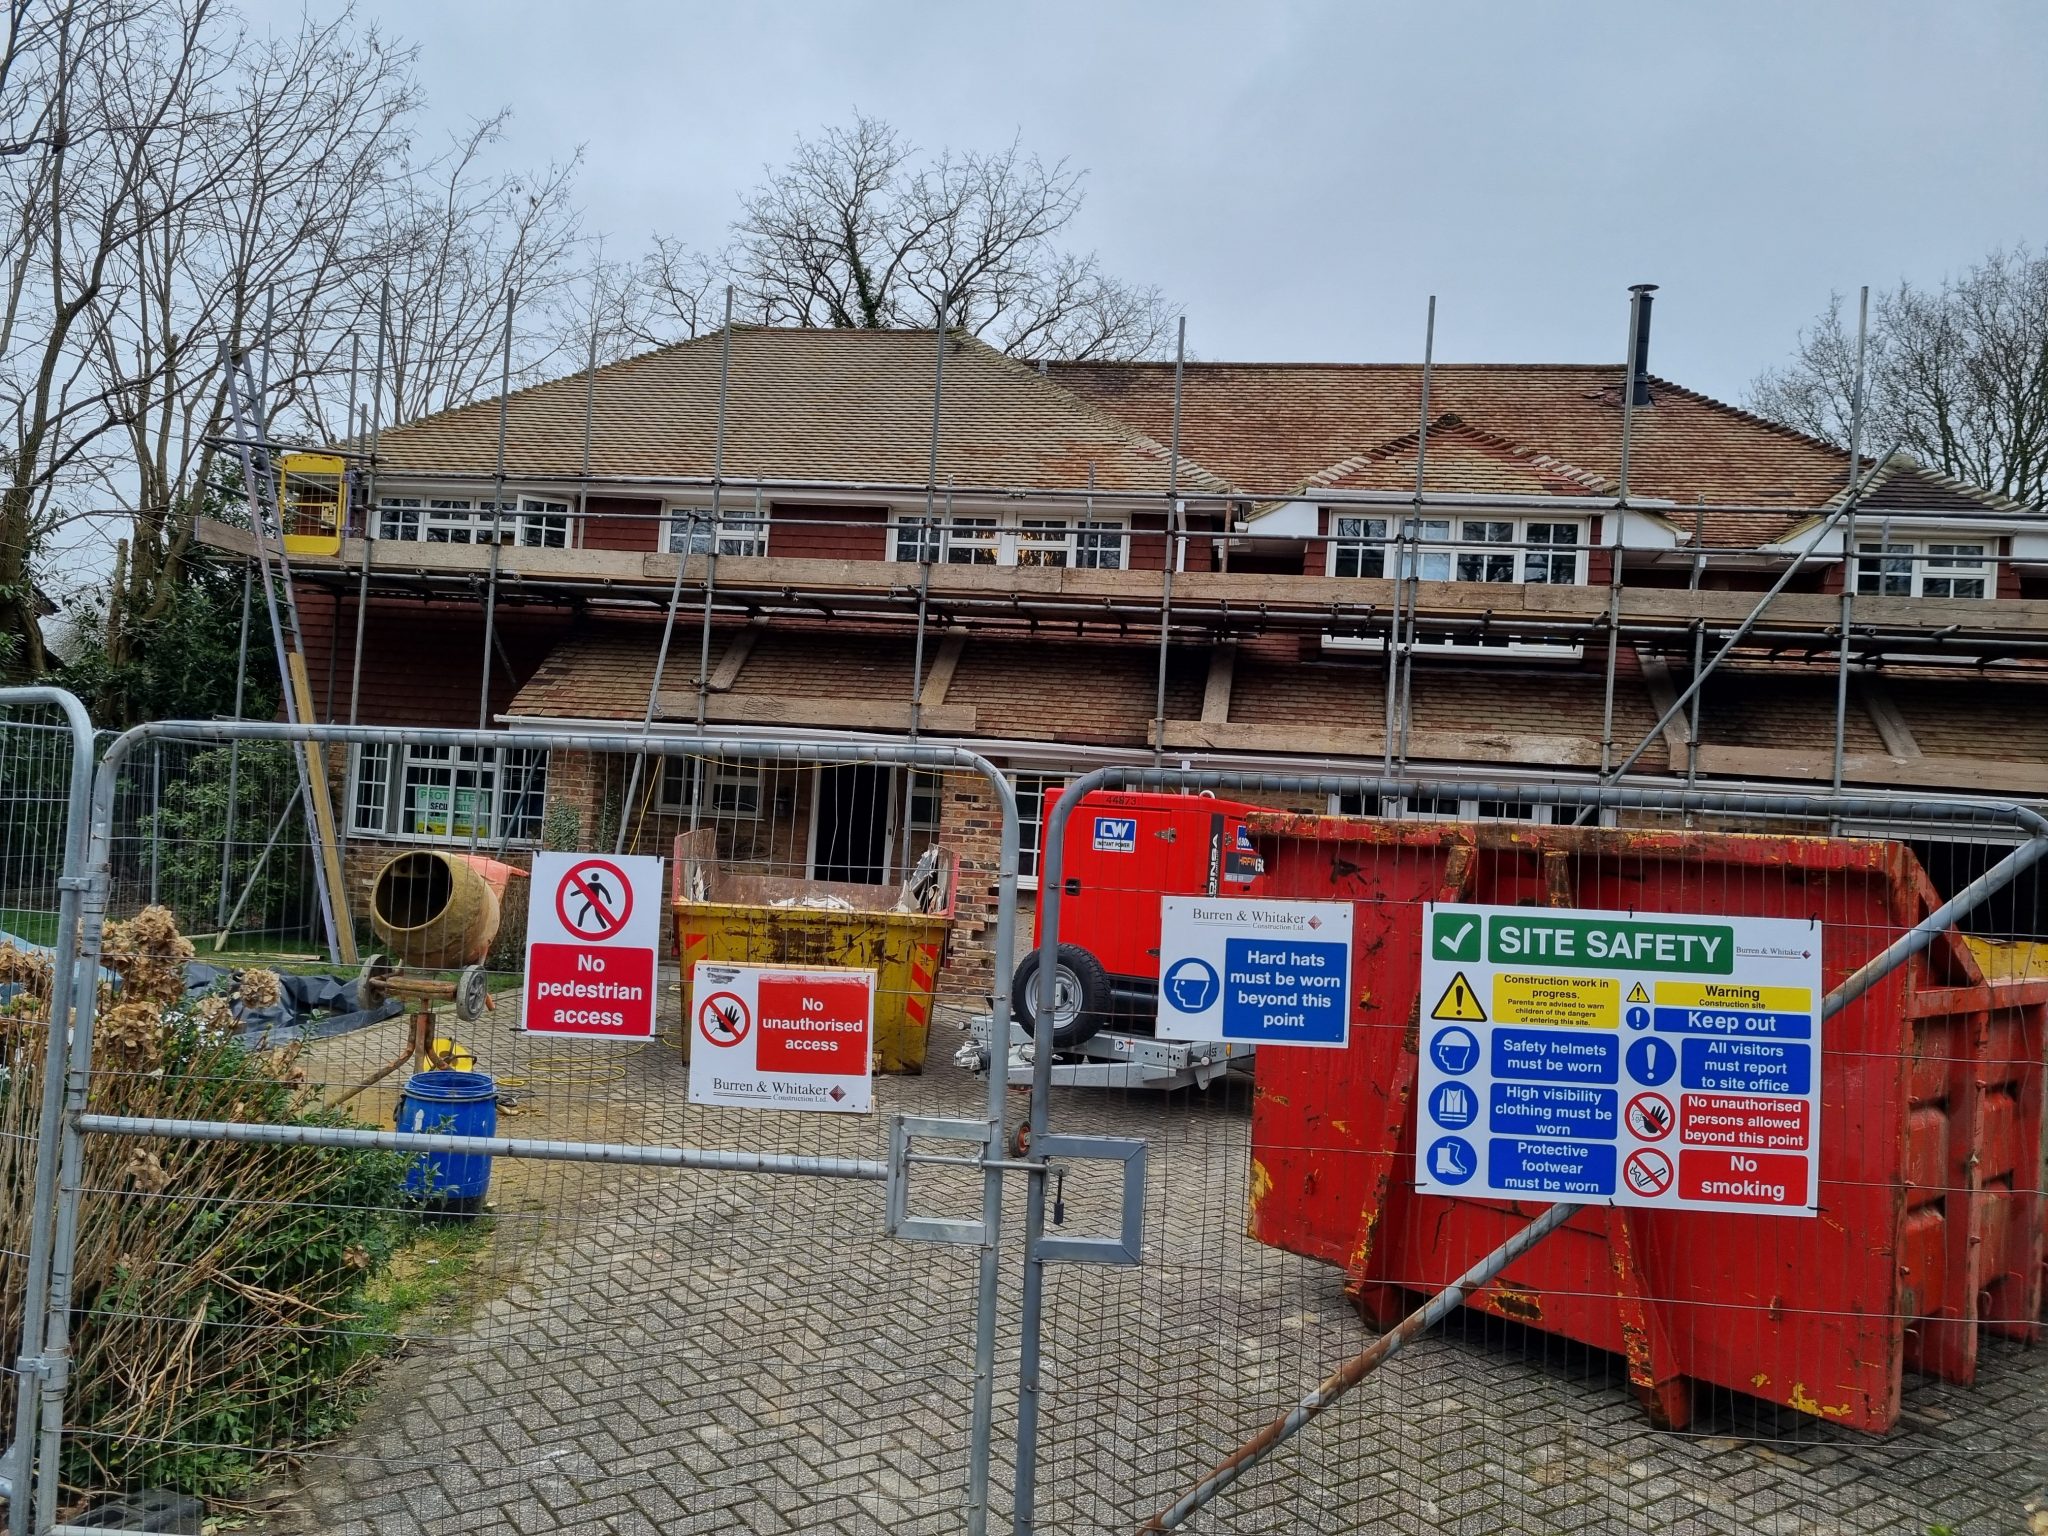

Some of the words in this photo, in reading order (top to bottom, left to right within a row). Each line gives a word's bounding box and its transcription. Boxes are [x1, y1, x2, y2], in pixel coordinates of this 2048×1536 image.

[420, 791, 483, 803] PROTCTE
[1100, 821, 1130, 838] CW
[1193, 907, 1233, 921] Burren
[1236, 910, 1248, 922] &
[1251, 910, 1306, 924] Whitaker
[1252, 922, 1292, 931] Construction
[1499, 926, 1575, 957] SITE
[1586, 930, 1722, 963] SAFETY
[1736, 946, 1760, 954] Burren
[1760, 947, 1768, 955] &
[1769, 947, 1802, 956] Whitaker
[578, 954, 605, 972] No
[1247, 950, 1286, 965] Hard
[1290, 952, 1326, 967] hats
[1230, 971, 1271, 985] must
[1275, 971, 1295, 986] be
[1299, 975, 1341, 988] worn
[1504, 974, 1569, 987] Construction
[1572, 978, 1597, 988] work
[1599, 979, 1609, 989] in
[537, 980, 642, 1000] pedestrian
[1532, 989, 1581, 1000] progress.
[1705, 985, 1760, 1001] Warning
[802, 997, 824, 1011] No
[1237, 990, 1298, 1008] beyond
[1301, 993, 1332, 1008] this
[1507, 998, 1535, 1007] Parents
[1536, 1000, 1547, 1008] are
[1548, 1000, 1577, 1009] advised
[1578, 1002, 1586, 1010] to
[1699, 999, 1749, 1009] Construction
[1751, 1001, 1766, 1010] site
[553, 1008, 624, 1026] access
[1263, 1012, 1305, 1028] point
[1515, 1007, 1544, 1016] children
[1545, 1008, 1554, 1016] of
[1554, 1009, 1566, 1017] the
[1567, 1010, 1597, 1019] dangers
[762, 1017, 863, 1032] unauthorised
[1529, 1017, 1559, 1026] entering
[1560, 1018, 1574, 1026] this
[1575, 1019, 1591, 1027] site.
[1688, 1011, 1739, 1034] Keep
[1744, 1016, 1777, 1032] out
[785, 1039, 839, 1052] access
[1503, 1039, 1547, 1056] Safety
[1551, 1041, 1607, 1057] helmets
[1707, 1041, 1727, 1054] All
[1731, 1043, 1784, 1057] visitors
[1507, 1058, 1542, 1070] must
[1546, 1059, 1564, 1071] be
[1567, 1062, 1602, 1073] worn
[1704, 1060, 1740, 1072] must
[1743, 1062, 1788, 1076] report
[713, 1077, 753, 1092] Burren
[756, 1081, 768, 1093] &
[772, 1081, 829, 1095] Whitaker
[1701, 1076, 1716, 1088] to
[1719, 1077, 1746, 1089] site
[1749, 1078, 1790, 1092] office
[773, 1094, 814, 1102] Construction
[1506, 1085, 1539, 1101] High
[1543, 1088, 1602, 1106] visibility
[1495, 1102, 1552, 1120] clothing
[1556, 1107, 1591, 1120] must
[1595, 1108, 1613, 1121] be
[1688, 1095, 1708, 1108] No
[1711, 1098, 1802, 1113] unauthorised
[1535, 1124, 1571, 1136] worn
[1688, 1114, 1744, 1127] persons
[1747, 1115, 1800, 1130] allowed
[1684, 1129, 1735, 1144] beyond
[1738, 1132, 1765, 1144] this
[1768, 1134, 1804, 1147] point
[1517, 1141, 1589, 1158] Protective
[1521, 1159, 1584, 1175] footwear
[1730, 1155, 1758, 1173] No
[1504, 1178, 1540, 1190] must
[1543, 1178, 1561, 1191] be
[1564, 1181, 1600, 1193] worn
[1701, 1180, 1786, 1202] smoking
